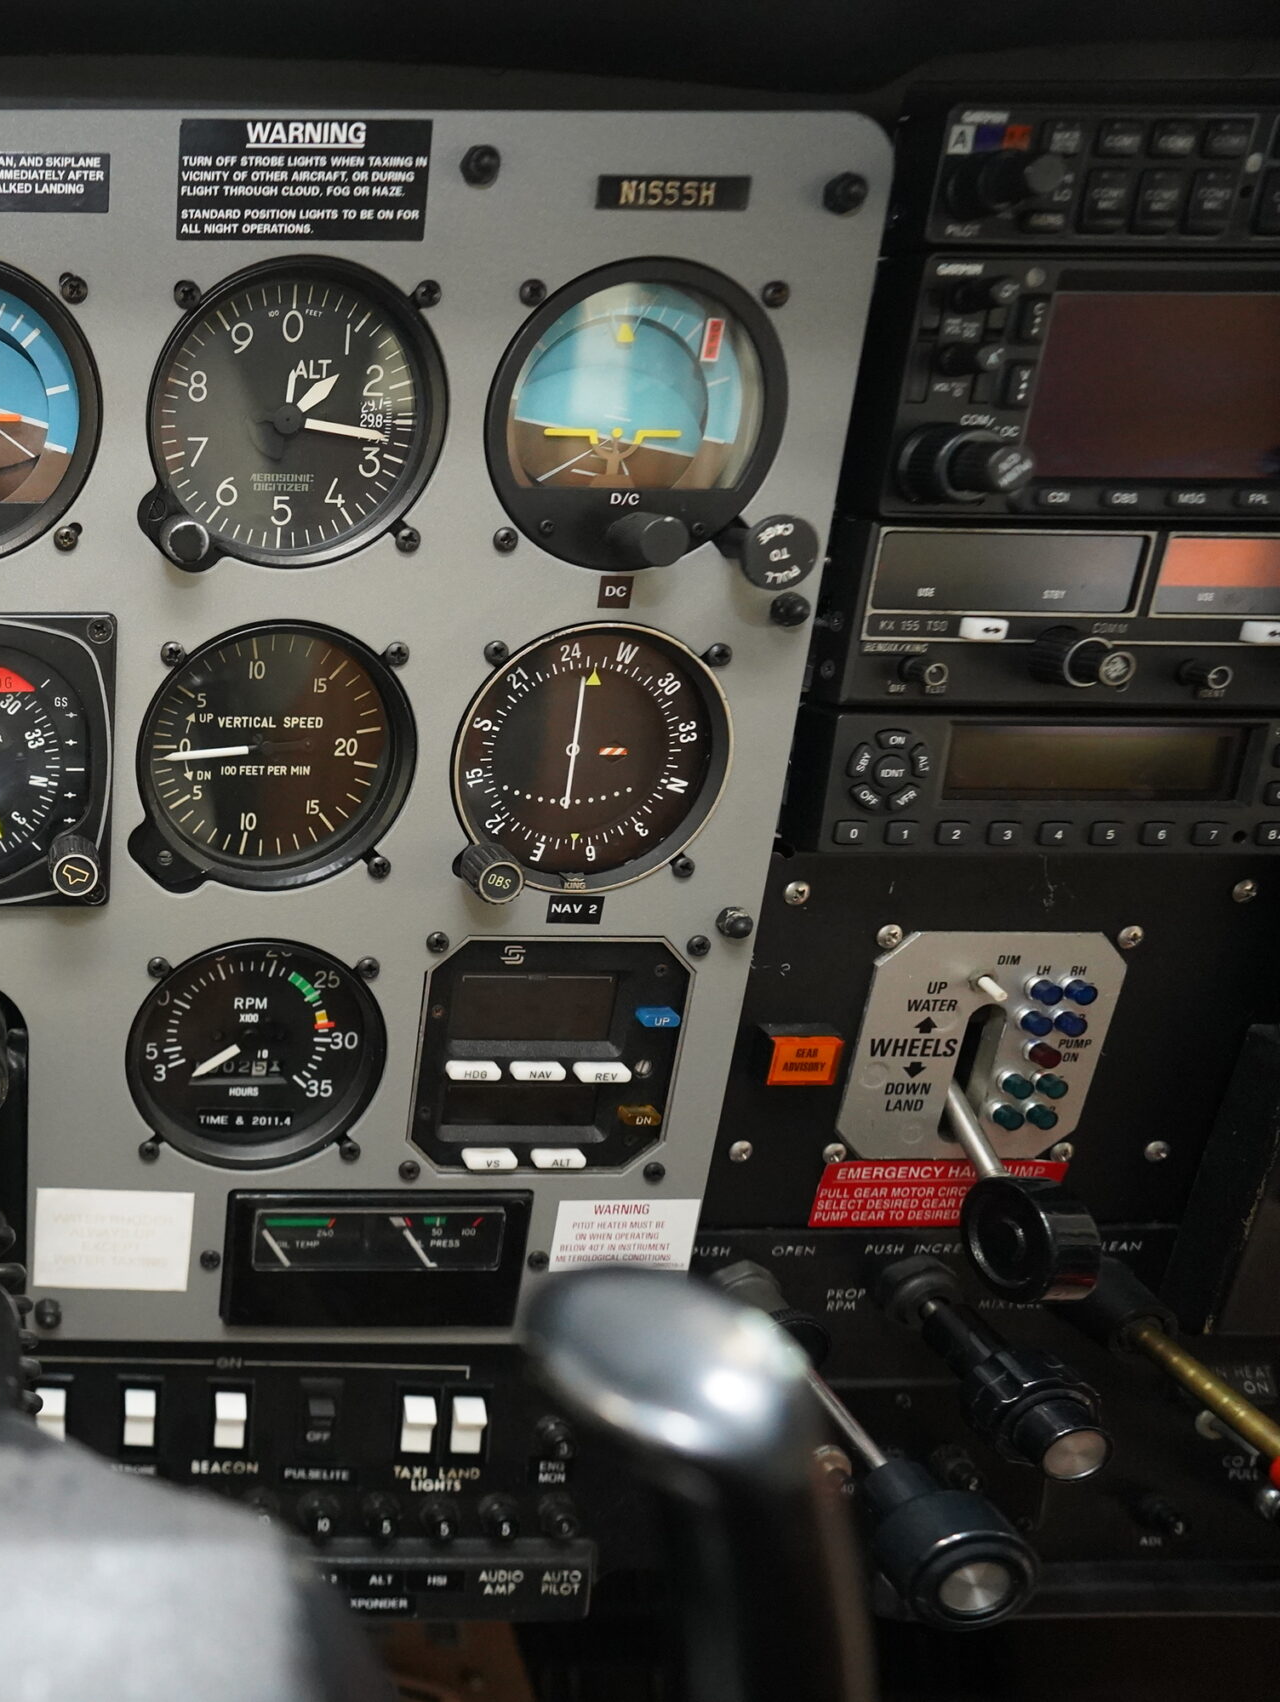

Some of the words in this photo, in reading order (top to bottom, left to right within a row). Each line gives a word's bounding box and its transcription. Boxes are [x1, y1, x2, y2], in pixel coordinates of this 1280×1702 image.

[247, 122, 366, 143] WARNING
[19, 157, 42, 167] AND
[46, 157, 101, 167] SKIPLANE
[183, 156, 212, 167] TURN
[216, 156, 237, 167] OFF
[240, 156, 284, 167] STROBE
[287, 156, 327, 167] LIGHTS
[330, 156, 364, 167] WHEN
[368, 156, 413, 167] TAXIING
[415, 156, 427, 167] IN
[68, 171, 104, 181] AFTER
[182, 171, 228, 182] VICINITY
[233, 171, 248, 182] OF
[251, 171, 288, 182] OTHER
[291, 171, 348, 182] AIRCRAFT,
[352, 171, 368, 182] OR
[371, 171, 415, 182] DURING
[35, 184, 84, 194] LANDING
[181, 186, 219, 197] FLIGHT
[223, 186, 277, 197] THROUGH
[281, 186, 323, 197] CLOUD,
[326, 186, 350, 197] FOG
[353, 186, 369, 197] OR
[372, 186, 405, 197] HAZE.
[181, 209, 240, 220] STANDARD
[244, 209, 296, 220] POSITION
[299, 209, 338, 220] LIGHTS
[342, 209, 356, 220] TO
[360, 209, 374, 220] BE
[377, 209, 393, 220] ON
[396, 209, 419, 220] FOR
[181, 224, 200, 234] ALL
[204, 224, 238, 234] NIGHT
[242, 224, 314, 234] OPERATIONS.
[283, 310, 303, 343] 0
[232, 322, 253, 354] 9
[294, 360, 332, 379] ALT
[189, 370, 207, 402] 8
[363, 365, 384, 397] 2
[187, 437, 208, 467] 7
[359, 447, 380, 477] 3
[250, 473, 314, 483] AEROSONIC
[216, 477, 238, 506] 6
[253, 482, 309, 492] DIGITIZER
[324, 477, 345, 508] 4
[610, 492, 640, 506] D/C
[271, 496, 292, 526] 5
[605, 584, 627, 598] DC
[249, 661, 265, 679] 10
[54, 697, 68, 707] GS
[199, 714, 214, 723] UP
[218, 717, 276, 728] VERTICAL
[283, 717, 323, 728] SPEED
[334, 738, 358, 756] 20
[197, 771, 211, 780] DN
[220, 766, 236, 776] 100
[239, 766, 264, 775] FEET
[267, 766, 288, 775] PER
[291, 766, 311, 775] MIN
[487, 873, 512, 889] OBS
[551, 903, 583, 915] NAV
[589, 903, 597, 915] 2
[314, 971, 340, 988] 25
[927, 981, 948, 994] UP
[234, 997, 267, 1009] RPM
[908, 999, 958, 1013] WATER
[654, 1017, 670, 1026] UP
[330, 1032, 358, 1049] 30
[1058, 1039, 1092, 1049] PUMP
[795, 1048, 819, 1059] GEAR
[869, 1038, 959, 1057] WHEELS
[782, 1061, 826, 1073] ADVISORY
[465, 1070, 487, 1079] HDG
[529, 1070, 552, 1079] NAV
[595, 1072, 618, 1081] REV
[229, 1087, 259, 1096] HOURS
[306, 1080, 332, 1098] 35
[885, 1082, 932, 1095] DOWN
[885, 1099, 924, 1112] LAND
[199, 1116, 228, 1125] TIME
[236, 1116, 244, 1125] &
[252, 1116, 291, 1126] 2011.4
[636, 1116, 651, 1125] DN
[487, 1160, 500, 1168] VS
[552, 1159, 571, 1167] ALT
[837, 1167, 943, 1180] EMERGENCY
[594, 1204, 650, 1215] WARNING
[190, 1460, 259, 1474] BEACON
[394, 1465, 428, 1478] TAXI
[439, 1468, 481, 1480] LAND
[410, 1480, 462, 1492] LIGHTS
[478, 1569, 524, 1582] AUDIO
[542, 1570, 582, 1582] AUTO
[484, 1583, 516, 1595] AMP
[541, 1583, 580, 1596] PILOT
